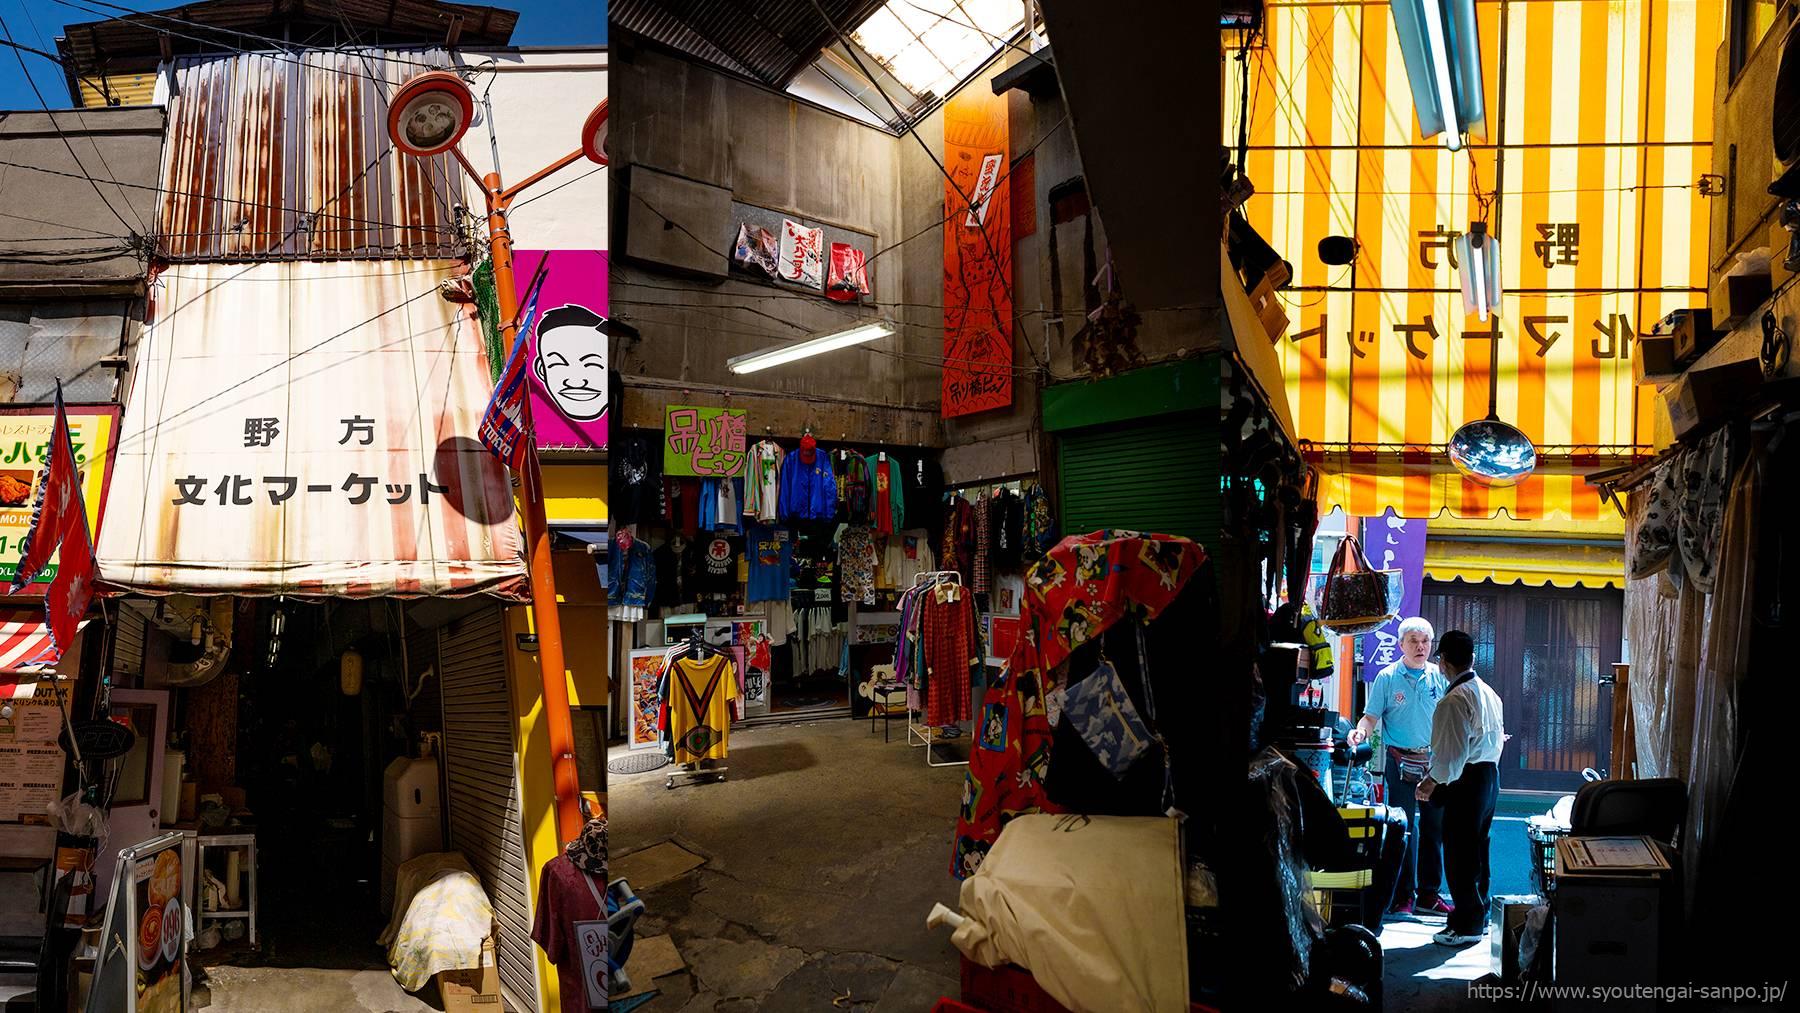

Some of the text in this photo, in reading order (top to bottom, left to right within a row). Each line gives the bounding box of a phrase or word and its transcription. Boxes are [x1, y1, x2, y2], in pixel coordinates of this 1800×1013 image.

[484, 422, 513, 457] TOKYO
[668, 408, 746, 455] 吊り橋
[172, 473, 449, 505] 文化マーケット
